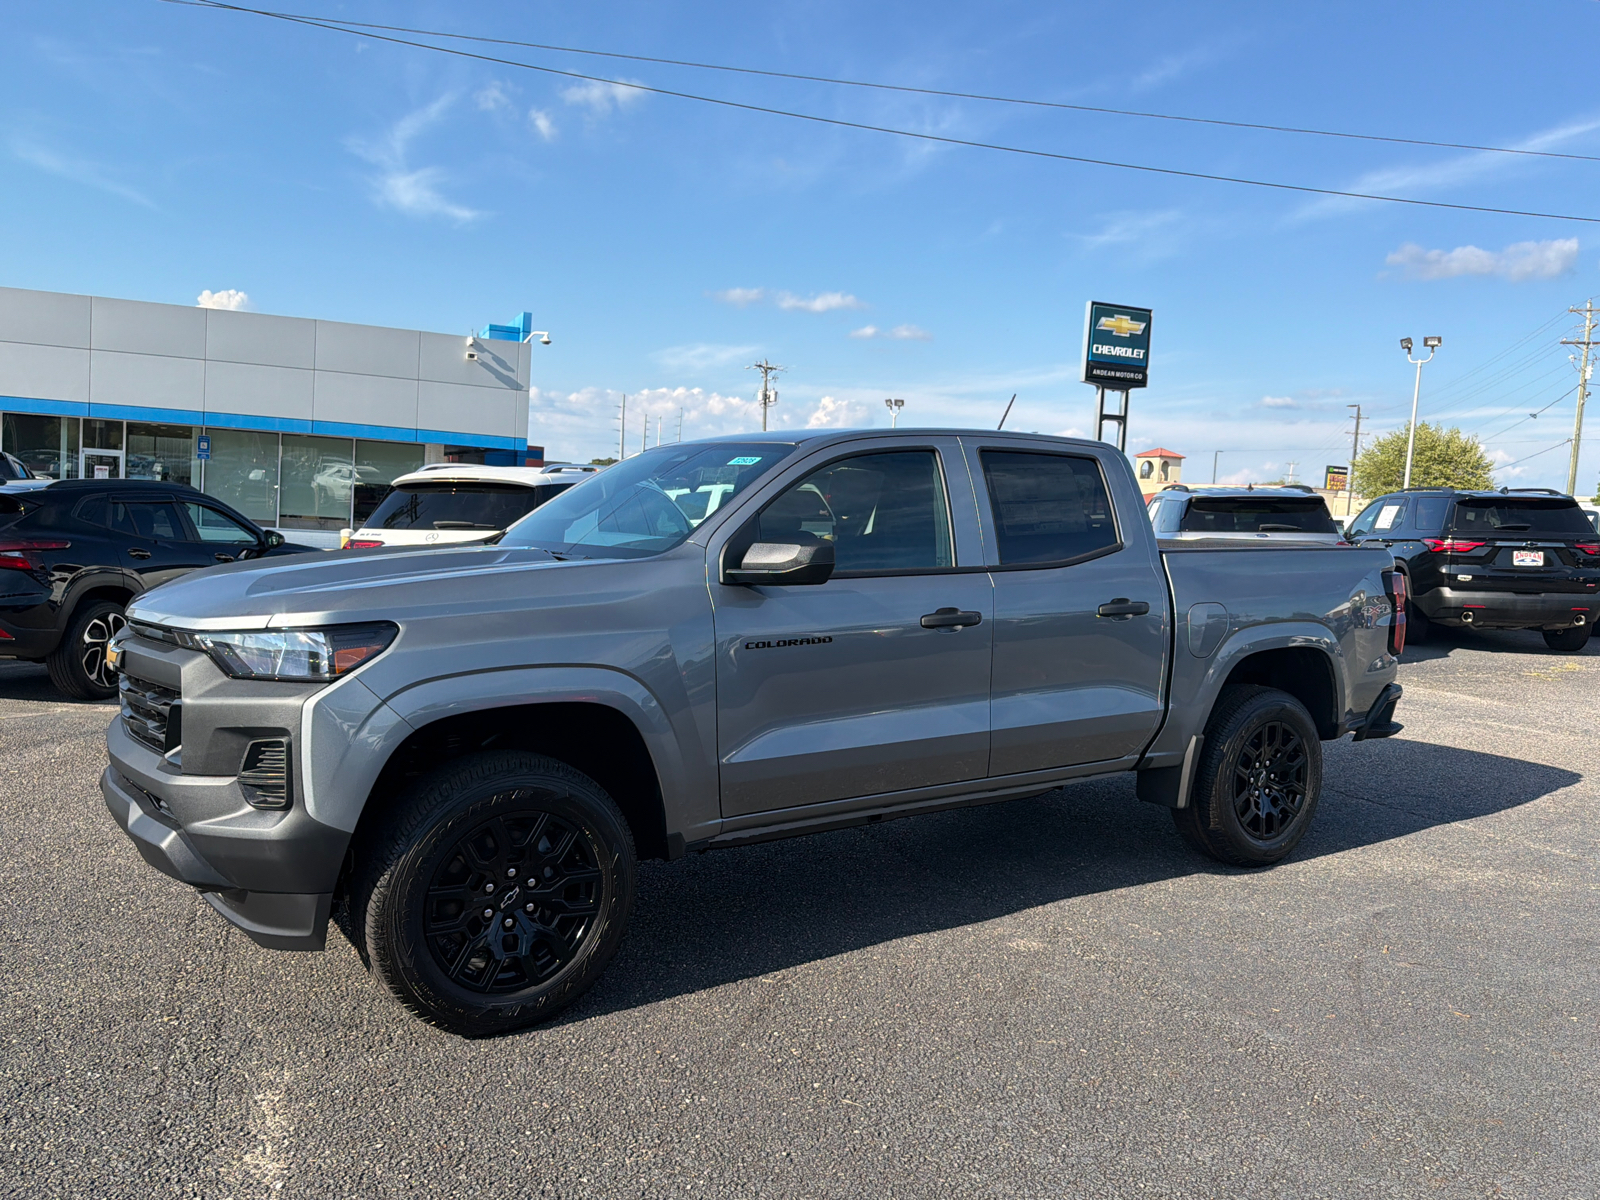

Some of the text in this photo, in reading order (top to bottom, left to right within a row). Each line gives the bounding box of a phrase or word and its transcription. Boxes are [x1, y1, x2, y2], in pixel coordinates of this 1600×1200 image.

[1092, 343, 1146, 359] CHEVROLET
[1092, 368, 1116, 377] ANDEAN
[1116, 370, 1134, 379] MOTOR
[744, 635, 833, 650] COLORADO
